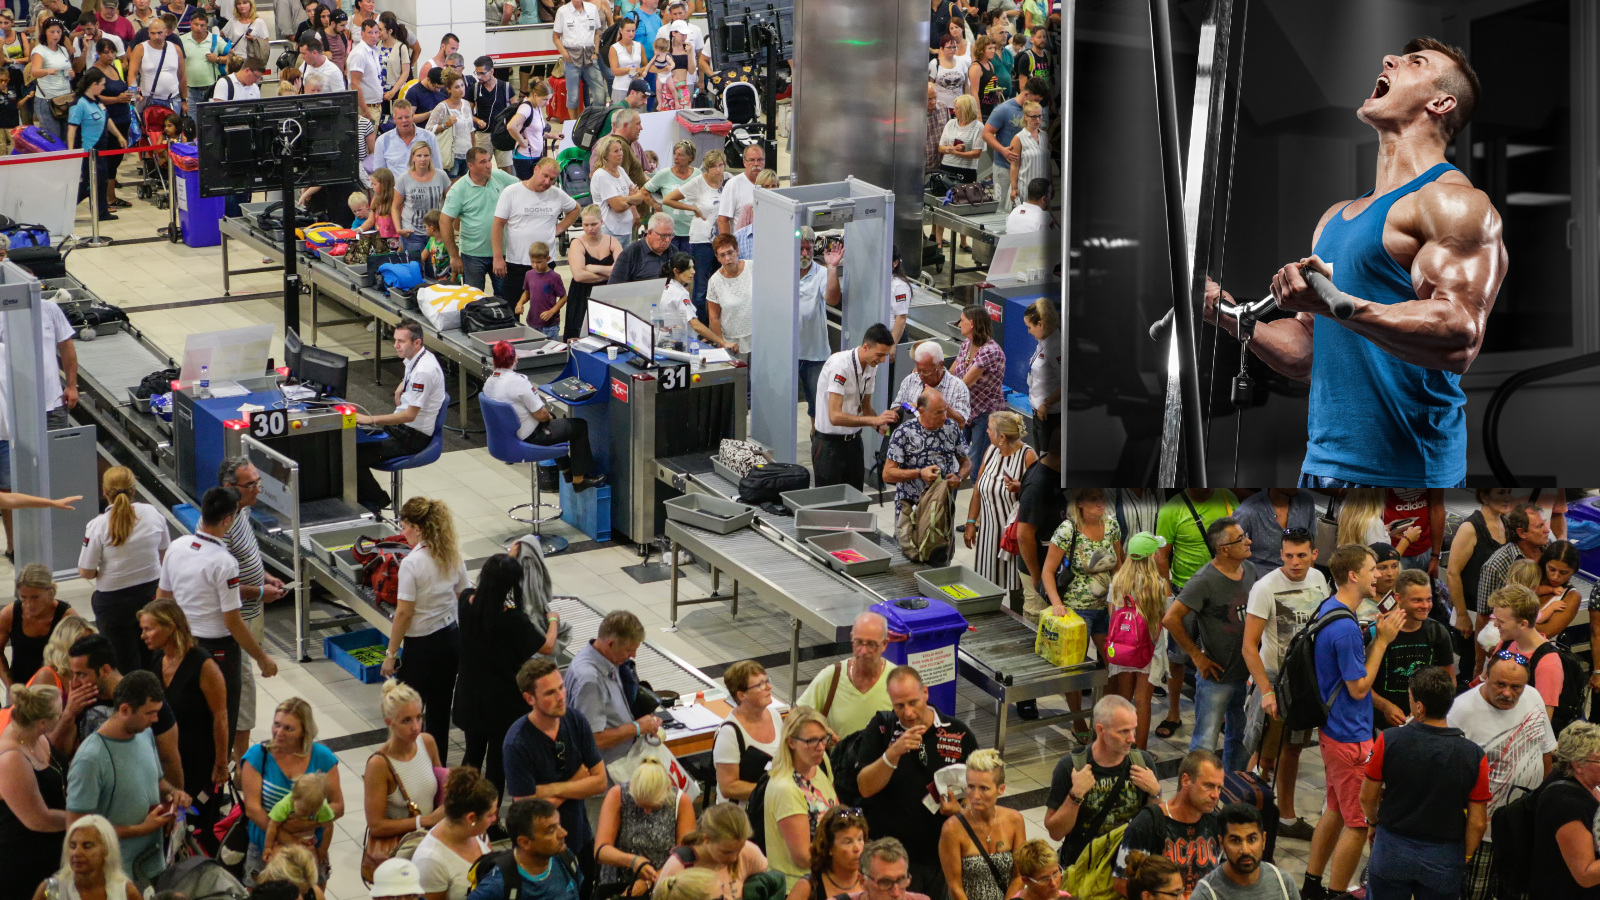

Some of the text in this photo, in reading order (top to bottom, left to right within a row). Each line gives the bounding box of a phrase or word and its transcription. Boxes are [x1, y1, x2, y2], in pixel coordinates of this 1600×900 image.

[662, 366, 686, 390] 31
[254, 412, 284, 437] 30
[1396, 500, 1427, 511] adidas
